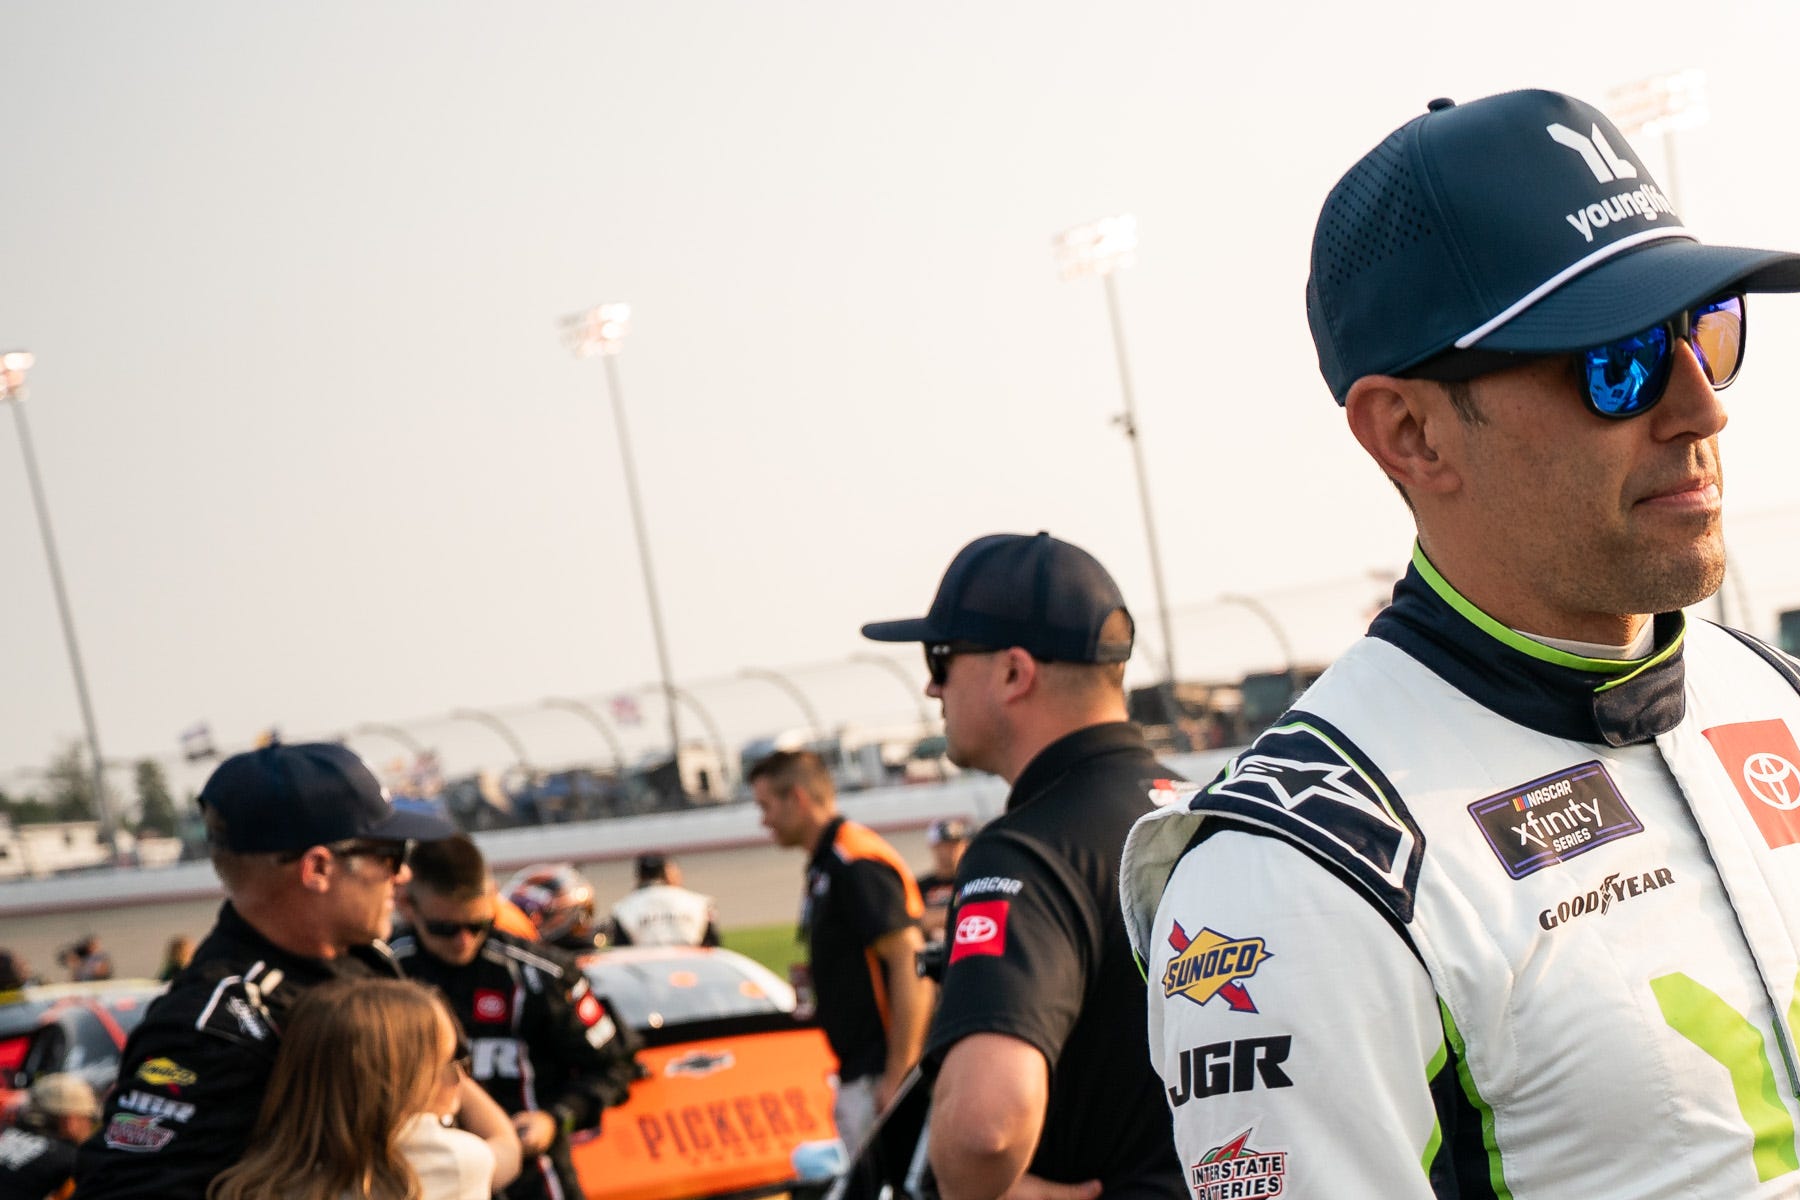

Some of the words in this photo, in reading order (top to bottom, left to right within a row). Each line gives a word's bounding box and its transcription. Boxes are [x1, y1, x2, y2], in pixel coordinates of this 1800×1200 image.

[1525, 779, 1573, 808] NASCAR
[1510, 797, 1603, 848] xfinity
[1552, 827, 1592, 853] SERIES
[963, 876, 1025, 897] NASCAR
[1538, 867, 1676, 931] GOODYEAR
[1166, 942, 1260, 992] SUNOCO
[1168, 1035, 1294, 1108] JGR
[637, 1086, 818, 1160] PICKERS
[1192, 1155, 1285, 1185] INTERSTATE
